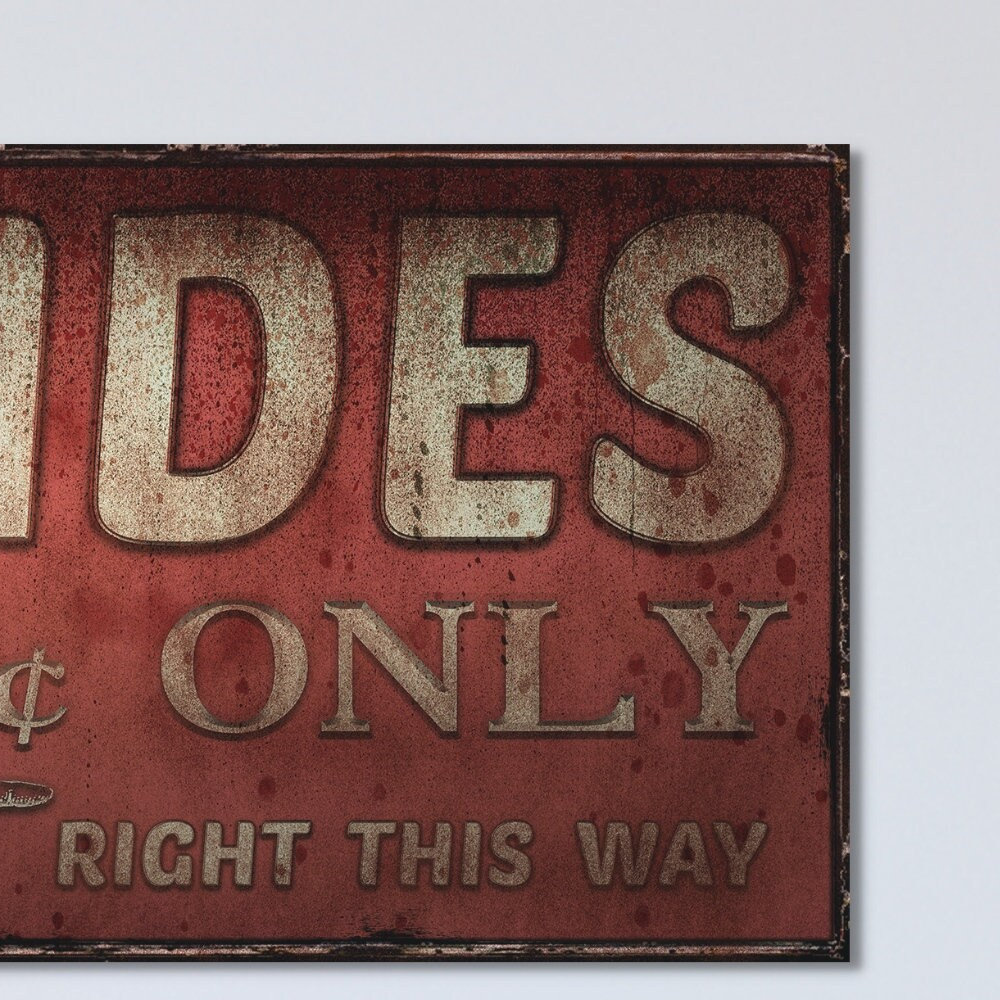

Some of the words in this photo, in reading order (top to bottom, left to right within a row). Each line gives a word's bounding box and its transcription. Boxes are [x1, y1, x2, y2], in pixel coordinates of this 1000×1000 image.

[160, 599, 789, 736] ONLY
[57, 820, 312, 889] RIGHT
[346, 820, 534, 889] THIS
[576, 820, 769, 889] WAY
